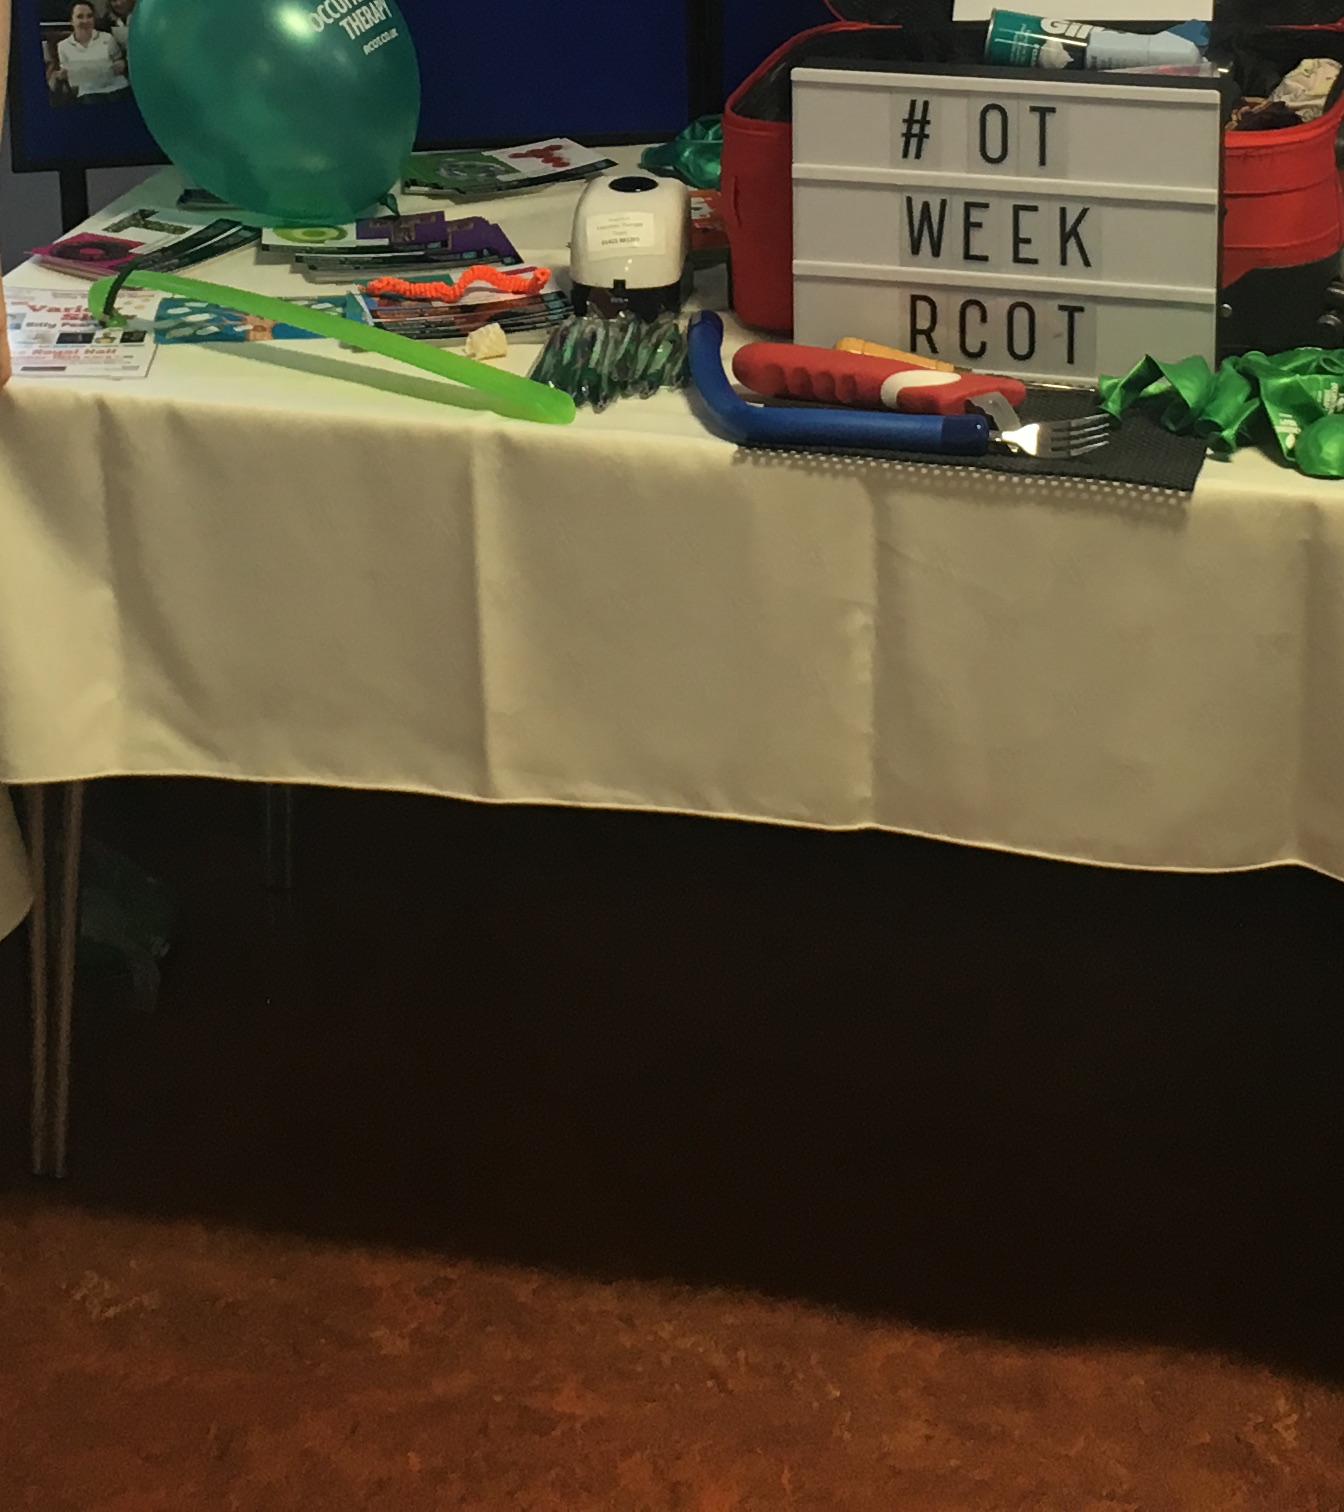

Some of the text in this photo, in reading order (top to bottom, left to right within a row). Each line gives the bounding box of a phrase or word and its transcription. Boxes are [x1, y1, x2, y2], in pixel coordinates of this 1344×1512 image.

[900, 98, 1057, 167] # OT
[905, 195, 1093, 268] WEEK
[909, 294, 1085, 365] RCOT
